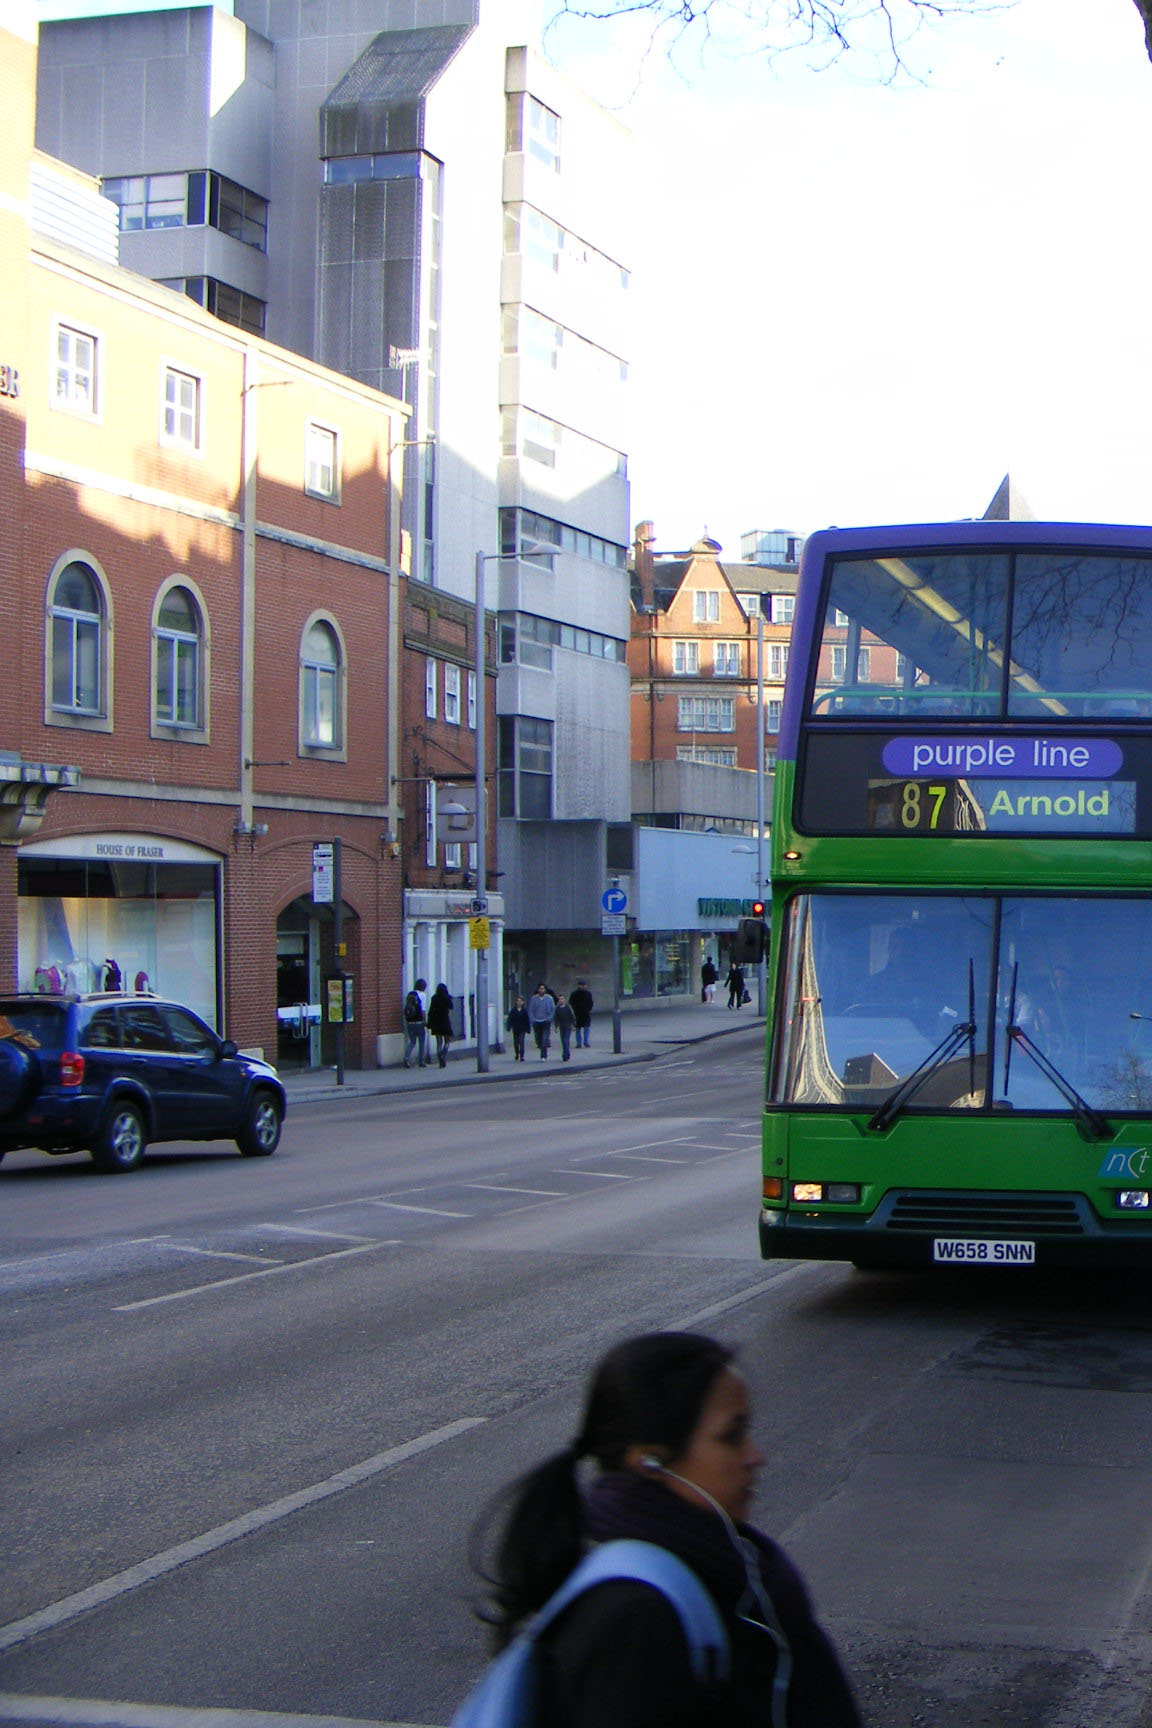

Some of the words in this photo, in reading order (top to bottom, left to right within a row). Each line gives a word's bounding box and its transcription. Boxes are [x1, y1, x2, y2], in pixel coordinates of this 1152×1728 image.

[912, 739, 1016, 772] purple
[1032, 739, 1090, 768] line
[901, 782, 947, 830] 87
[988, 789, 1110, 817] Arnold
[96, 844, 124, 856] HOUSE
[125, 845, 136, 857] OF
[137, 846, 164, 858] FRASER
[937, 1241, 988, 1260] W658
[993, 1244, 1033, 1261] SNN
